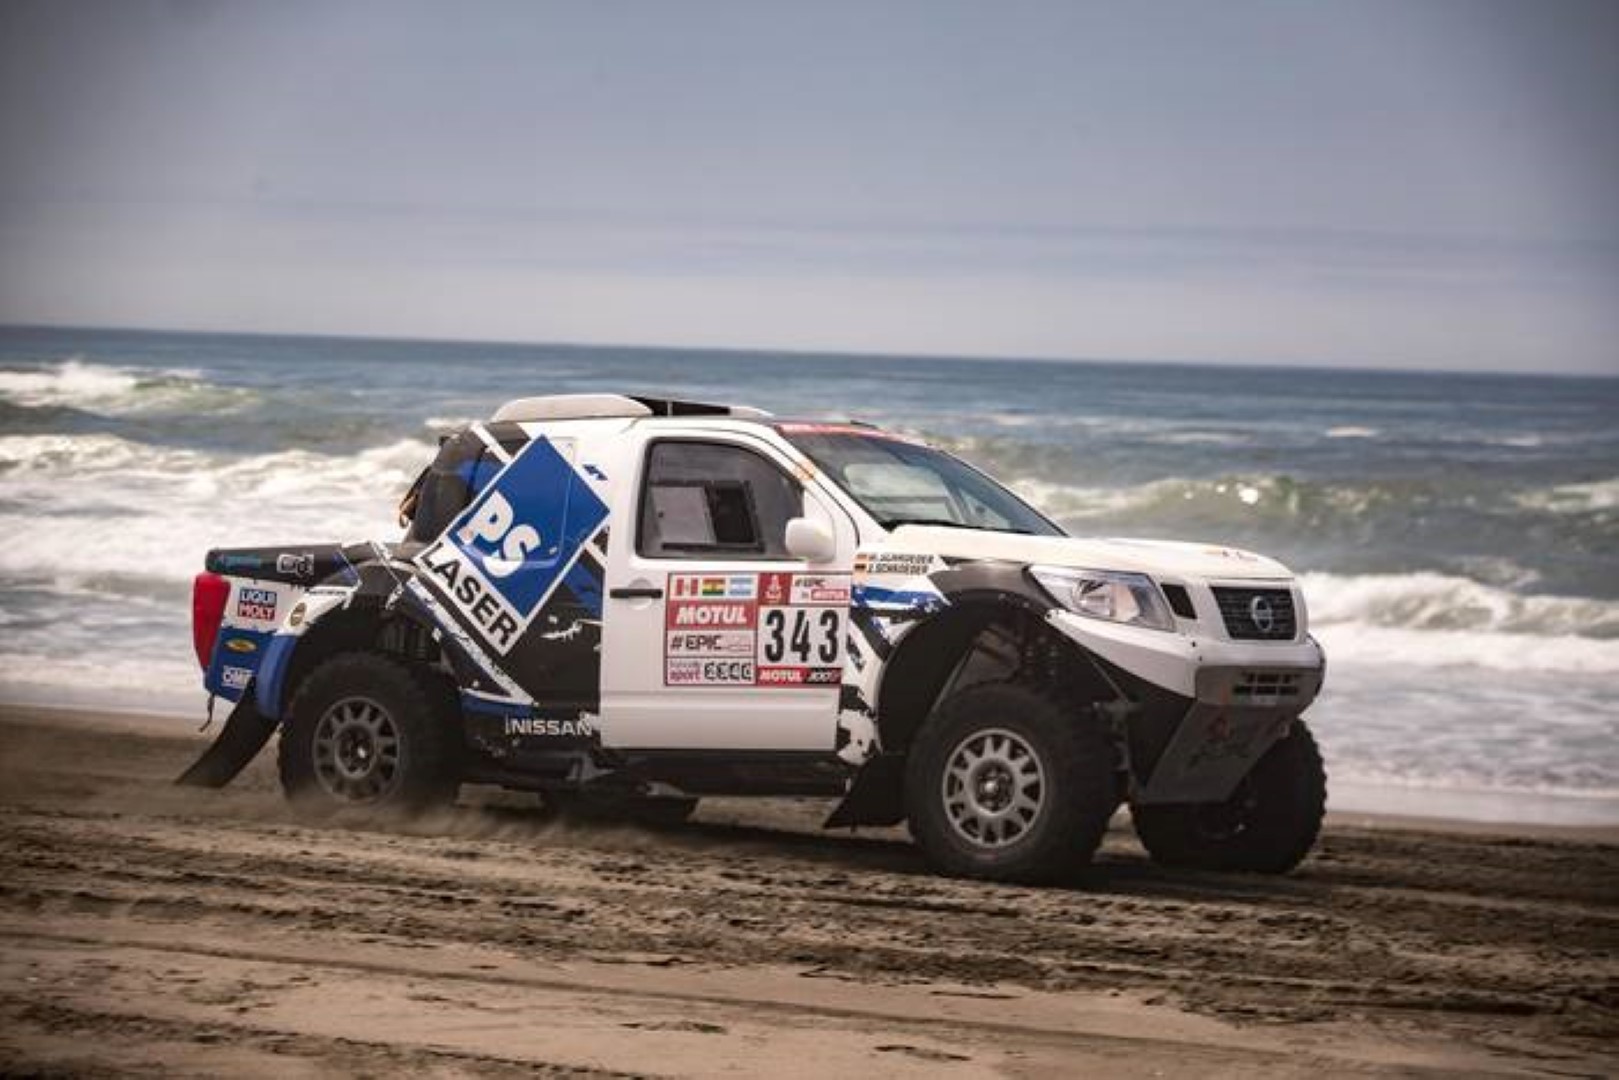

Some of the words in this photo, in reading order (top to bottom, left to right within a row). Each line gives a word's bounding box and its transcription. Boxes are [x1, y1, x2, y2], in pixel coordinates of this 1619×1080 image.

[456, 490, 541, 578] PS
[419, 542, 519, 646] LASER
[676, 606, 748, 624] MOTUL
[669, 635, 723, 650] #EPIC
[764, 609, 839, 664] 343
[759, 670, 803, 682] MOTUL
[511, 718, 592, 736] NISSAN
